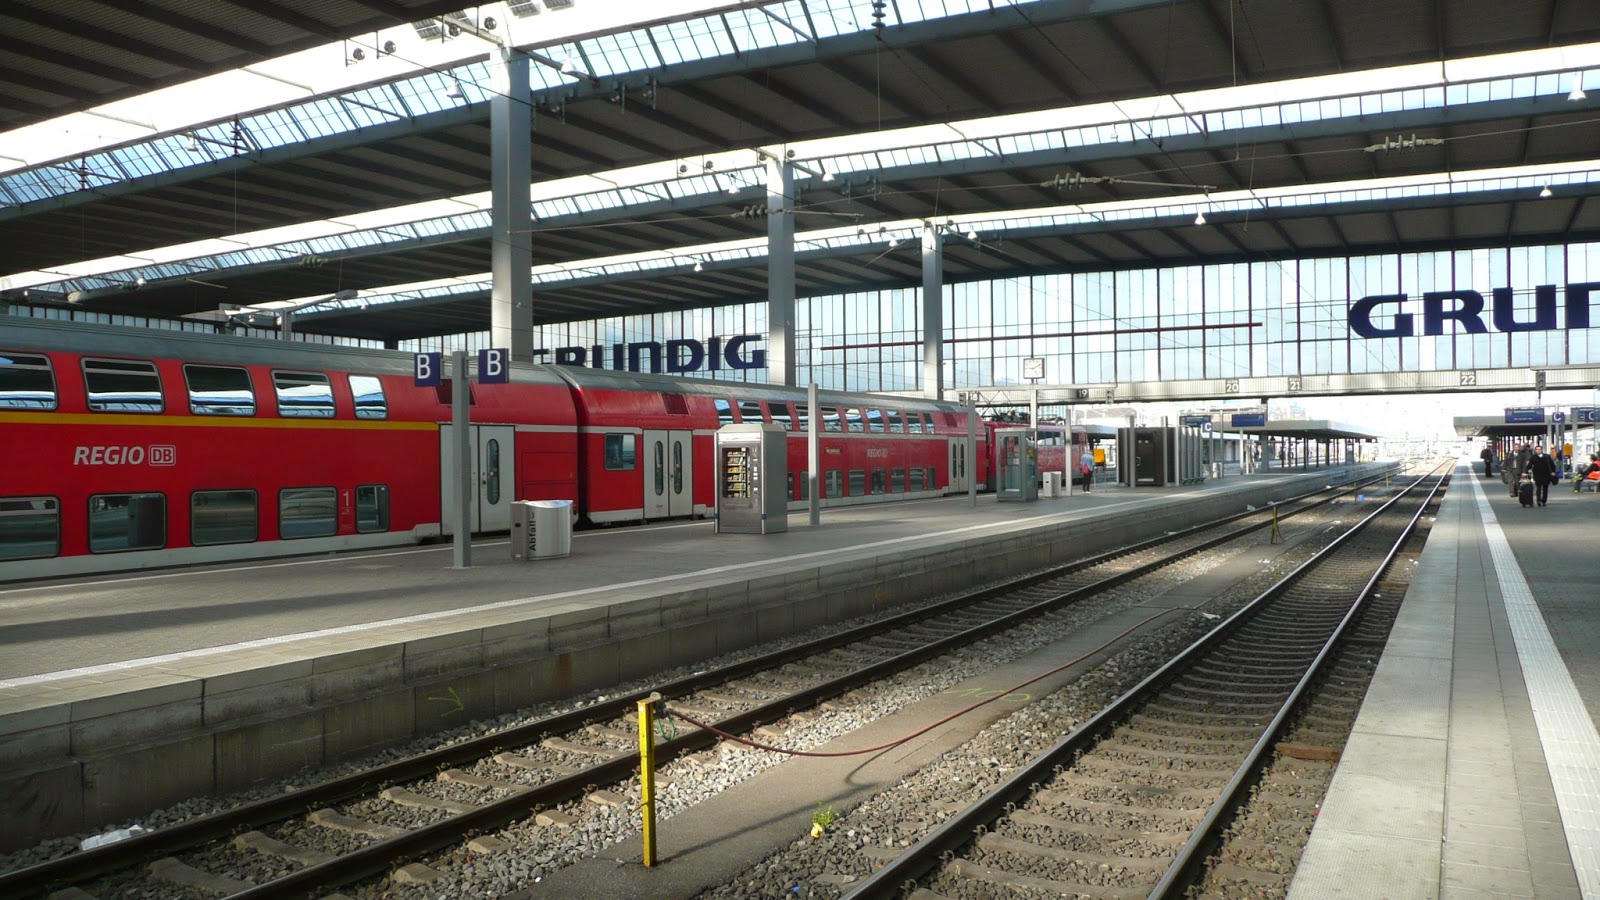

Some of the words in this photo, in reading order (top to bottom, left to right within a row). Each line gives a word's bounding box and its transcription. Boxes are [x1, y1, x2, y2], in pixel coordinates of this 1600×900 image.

[487, 350, 501, 376] B
[533, 335, 767, 374] RUNDIG
[417, 354, 431, 379] B
[1226, 383, 1239, 392] 20
[1290, 381, 1300, 390] 21
[1461, 375, 1476, 385] 22
[1553, 412, 1562, 422] C
[1204, 422, 1213, 432] C
[73, 445, 145, 466] REGIO
[148, 444, 177, 467] DB
[343, 490, 350, 507] 1
[529, 520, 537, 552] Abfall
